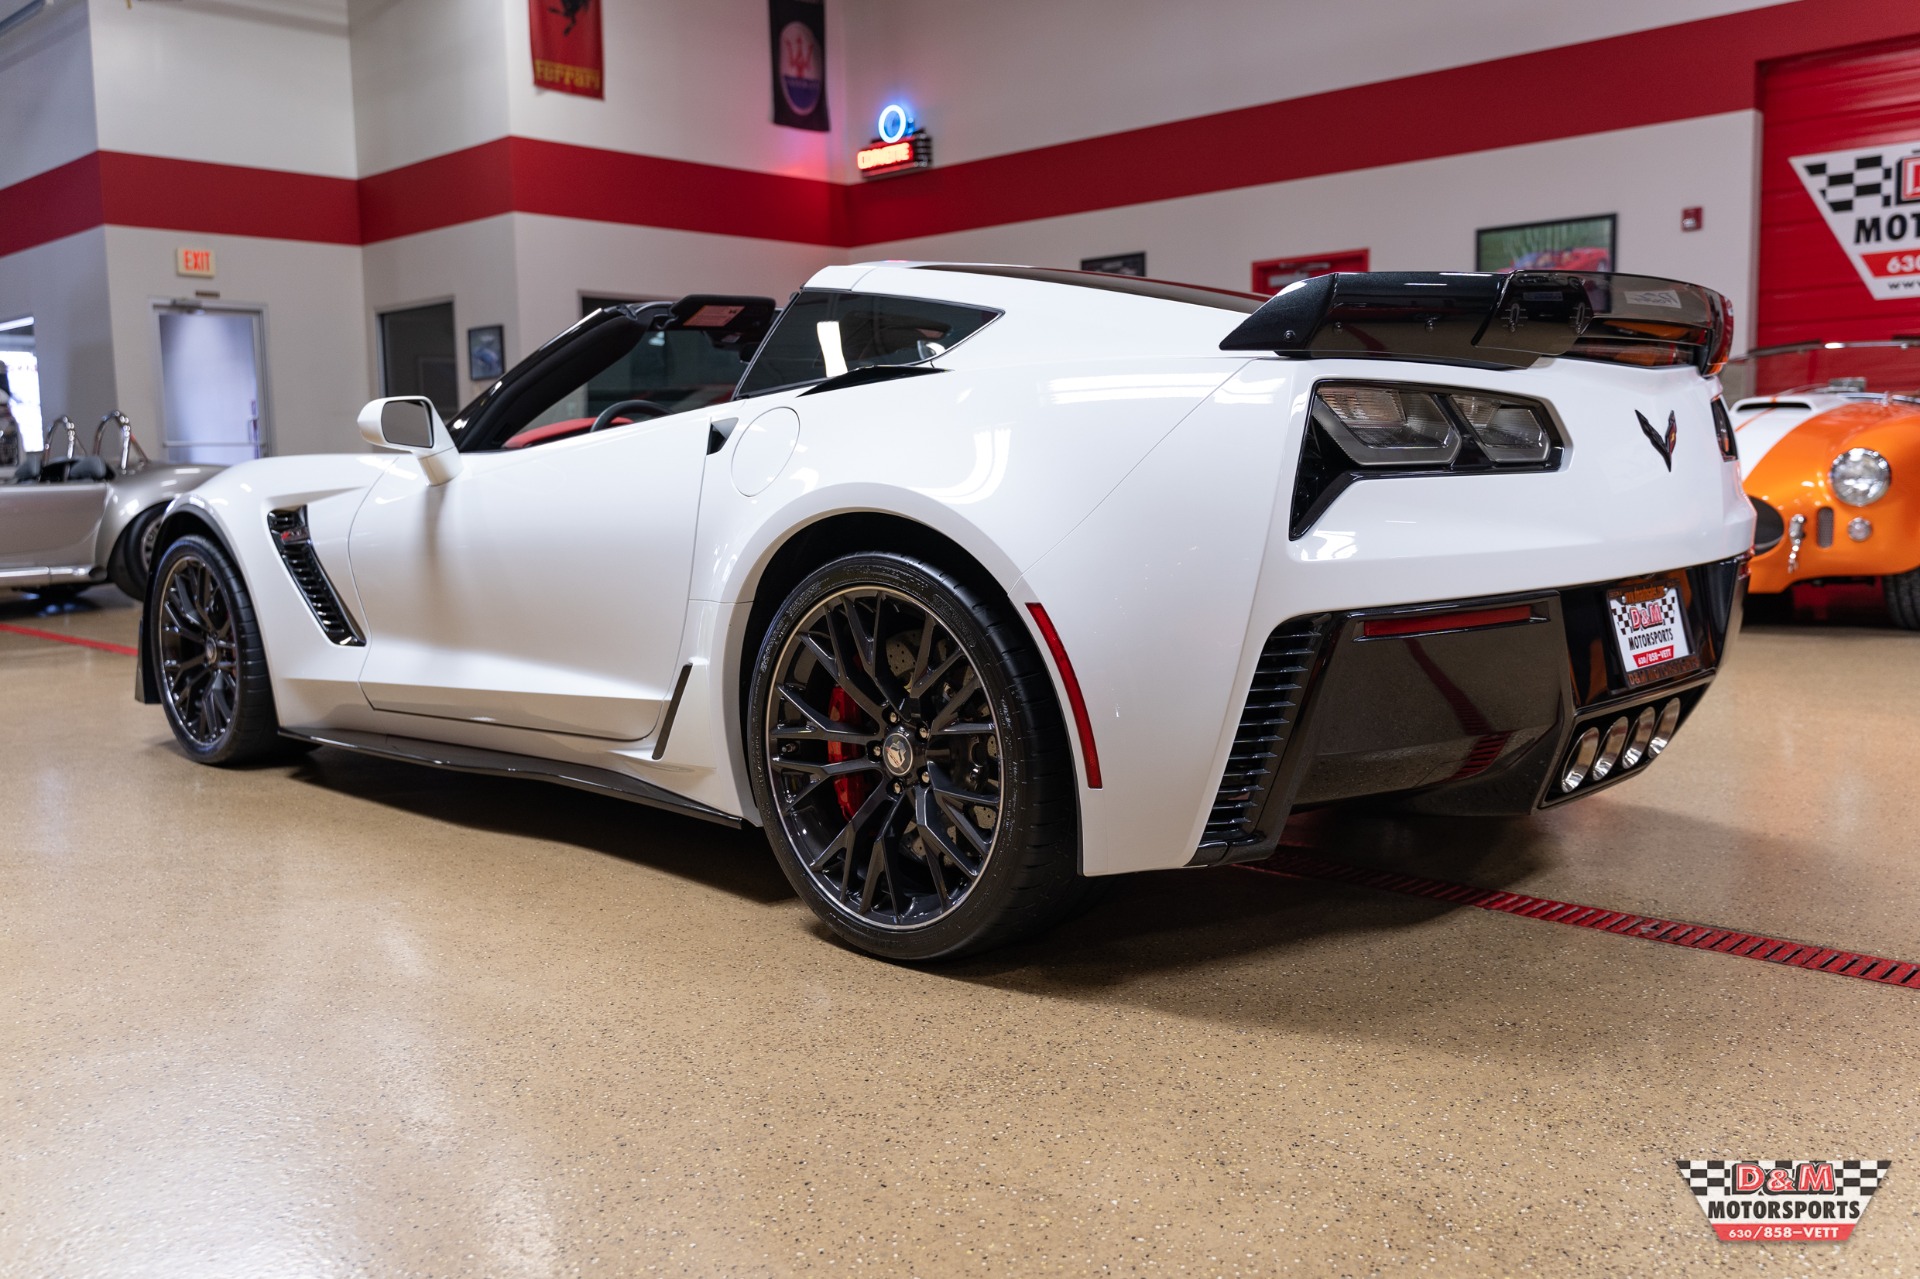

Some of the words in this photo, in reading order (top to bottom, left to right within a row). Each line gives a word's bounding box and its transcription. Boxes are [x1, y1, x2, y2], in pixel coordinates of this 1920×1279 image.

[534, 58, 601, 90] Ferrari
[183, 249, 211, 272] EXIT
[1630, 603, 1663, 630] D&M
[1628, 628, 1674, 651] MOTORSPORTS
